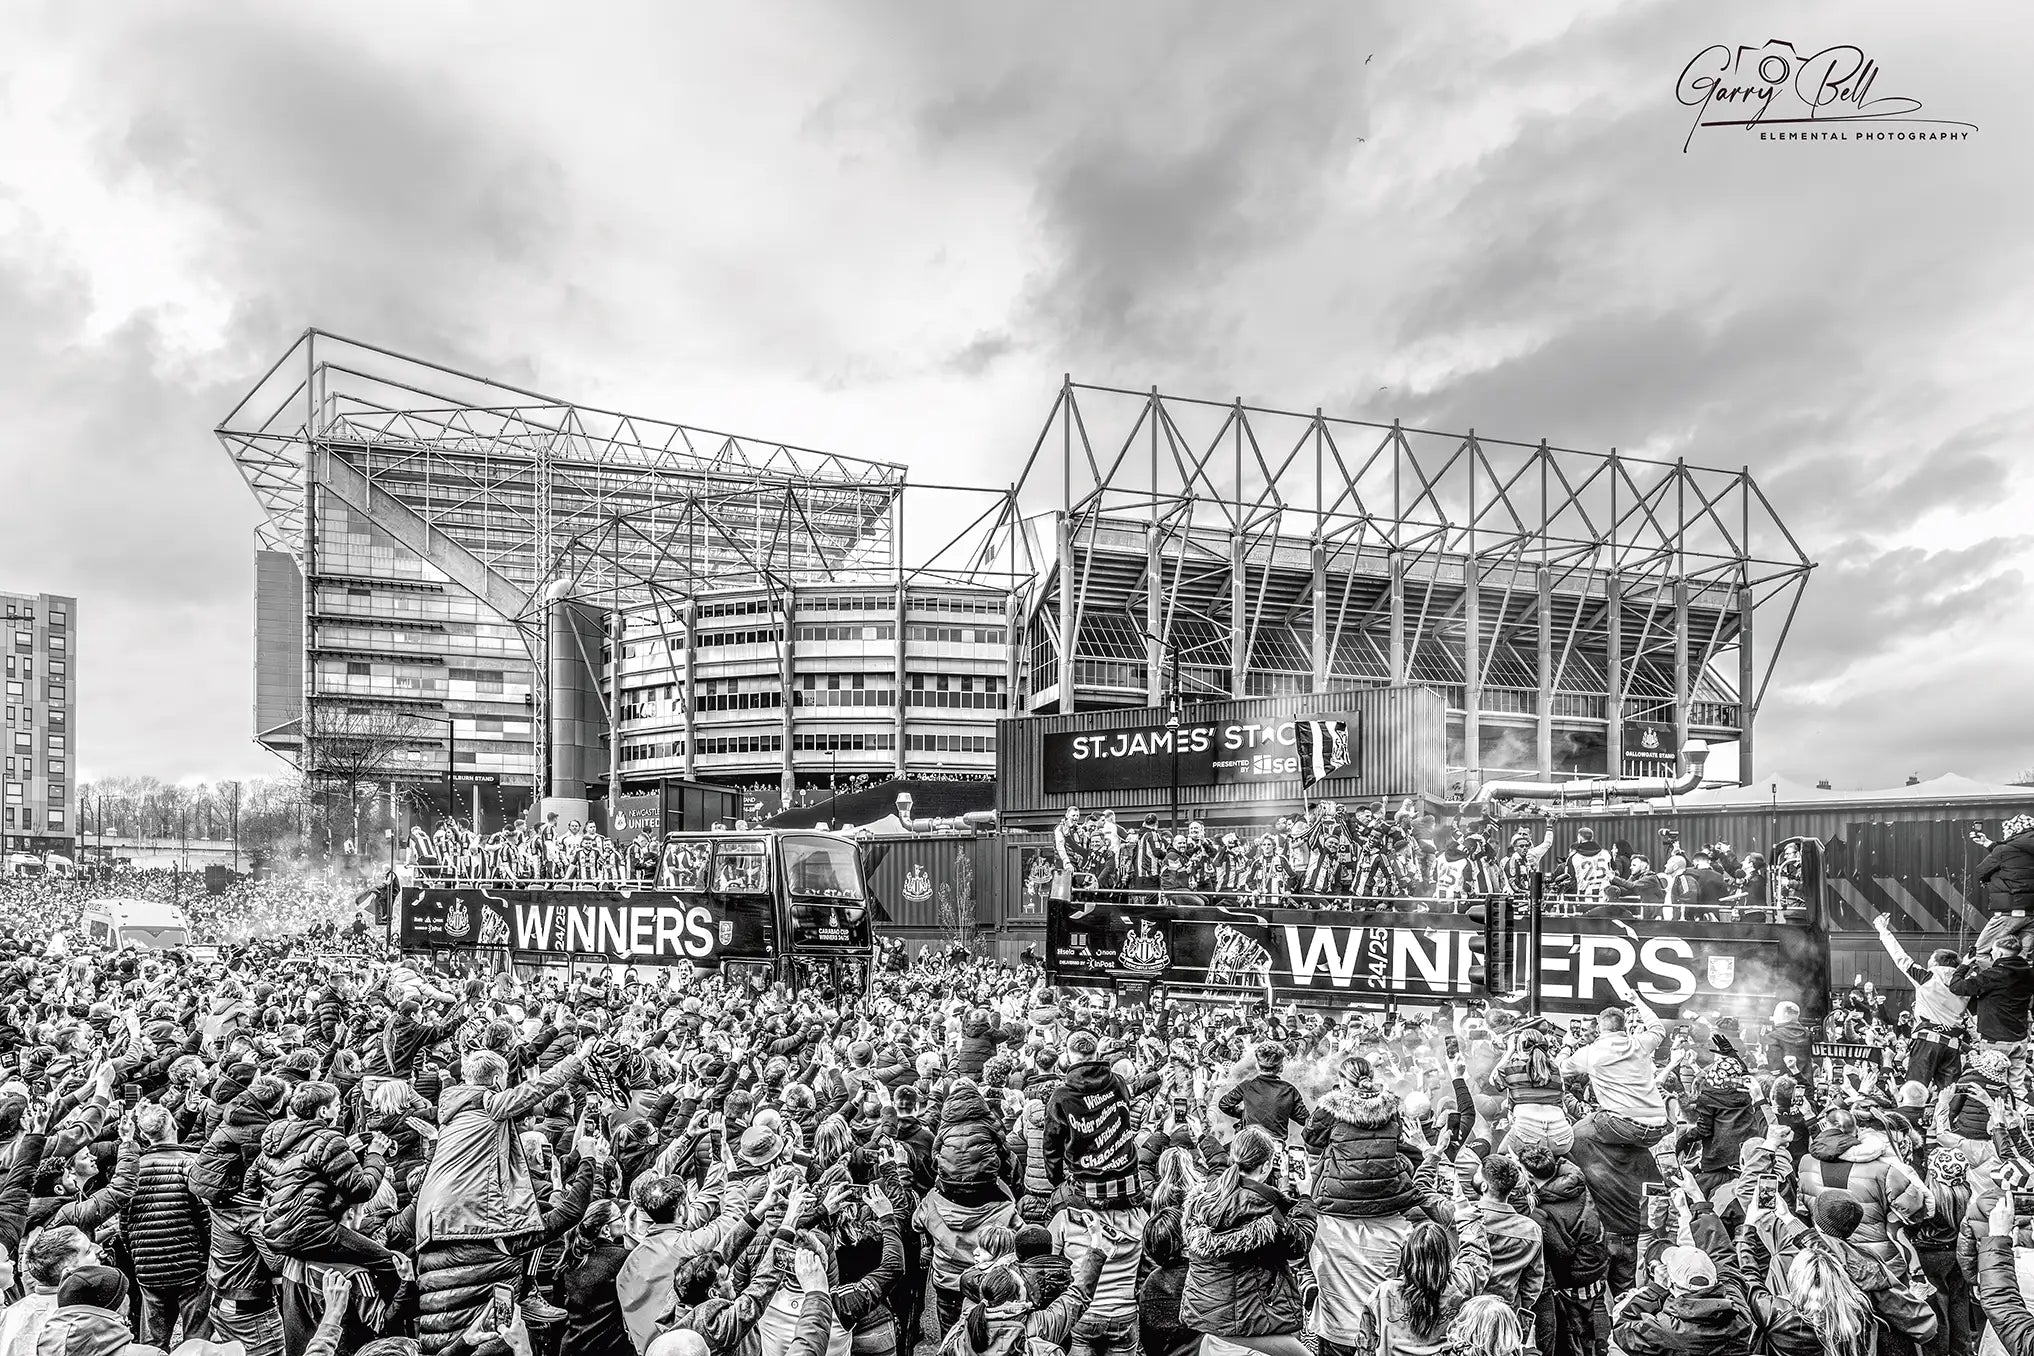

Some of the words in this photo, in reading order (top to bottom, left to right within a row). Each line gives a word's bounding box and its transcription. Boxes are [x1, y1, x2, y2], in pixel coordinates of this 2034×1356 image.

[1212, 759, 1250, 768] PRESENTED
[1625, 750, 1658, 759] GALLOWGATE
[1094, 960, 1115, 968] InPost
[1367, 927, 1389, 989] 24/25
[1083, 1091, 1115, 1110] Without
[1068, 1113, 1095, 1134] Order
[1095, 1102, 1117, 1129] nothing
[1094, 1116, 1122, 1149] Without
[1080, 1144, 1115, 1168] Chaos
[1114, 1129, 1134, 1151] nothin
